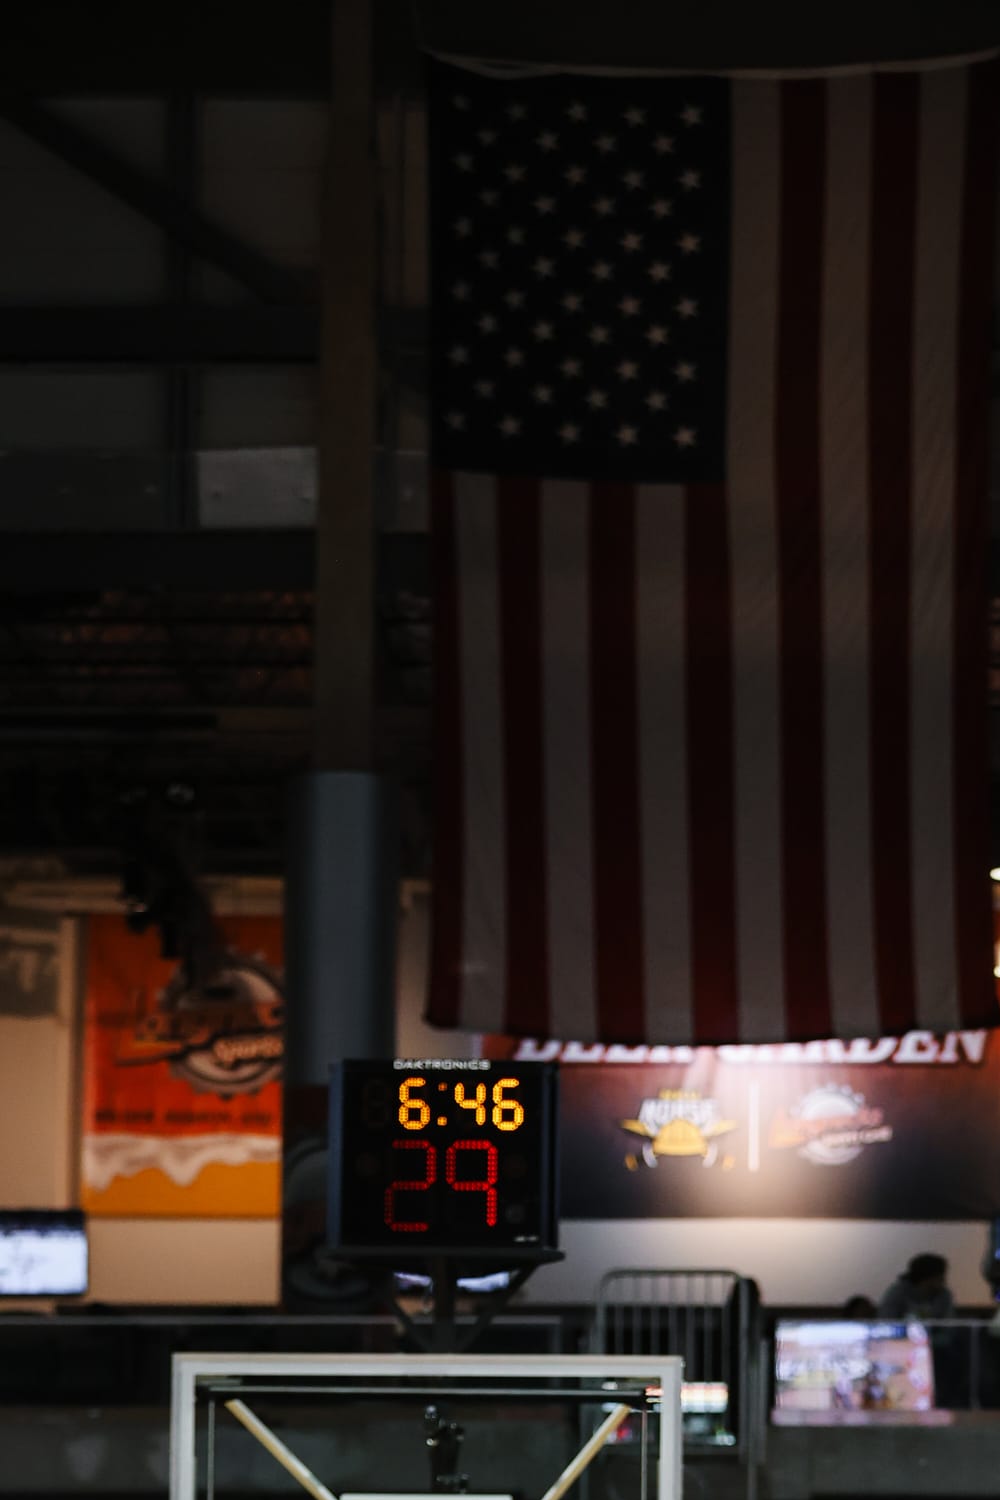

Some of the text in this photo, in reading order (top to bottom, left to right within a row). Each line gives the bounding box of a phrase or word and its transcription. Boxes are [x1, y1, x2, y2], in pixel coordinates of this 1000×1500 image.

[393, 1059, 491, 1071] DAKTRONICS
[398, 1077, 525, 1131] 6:46
[384, 1139, 498, 1232] 29
